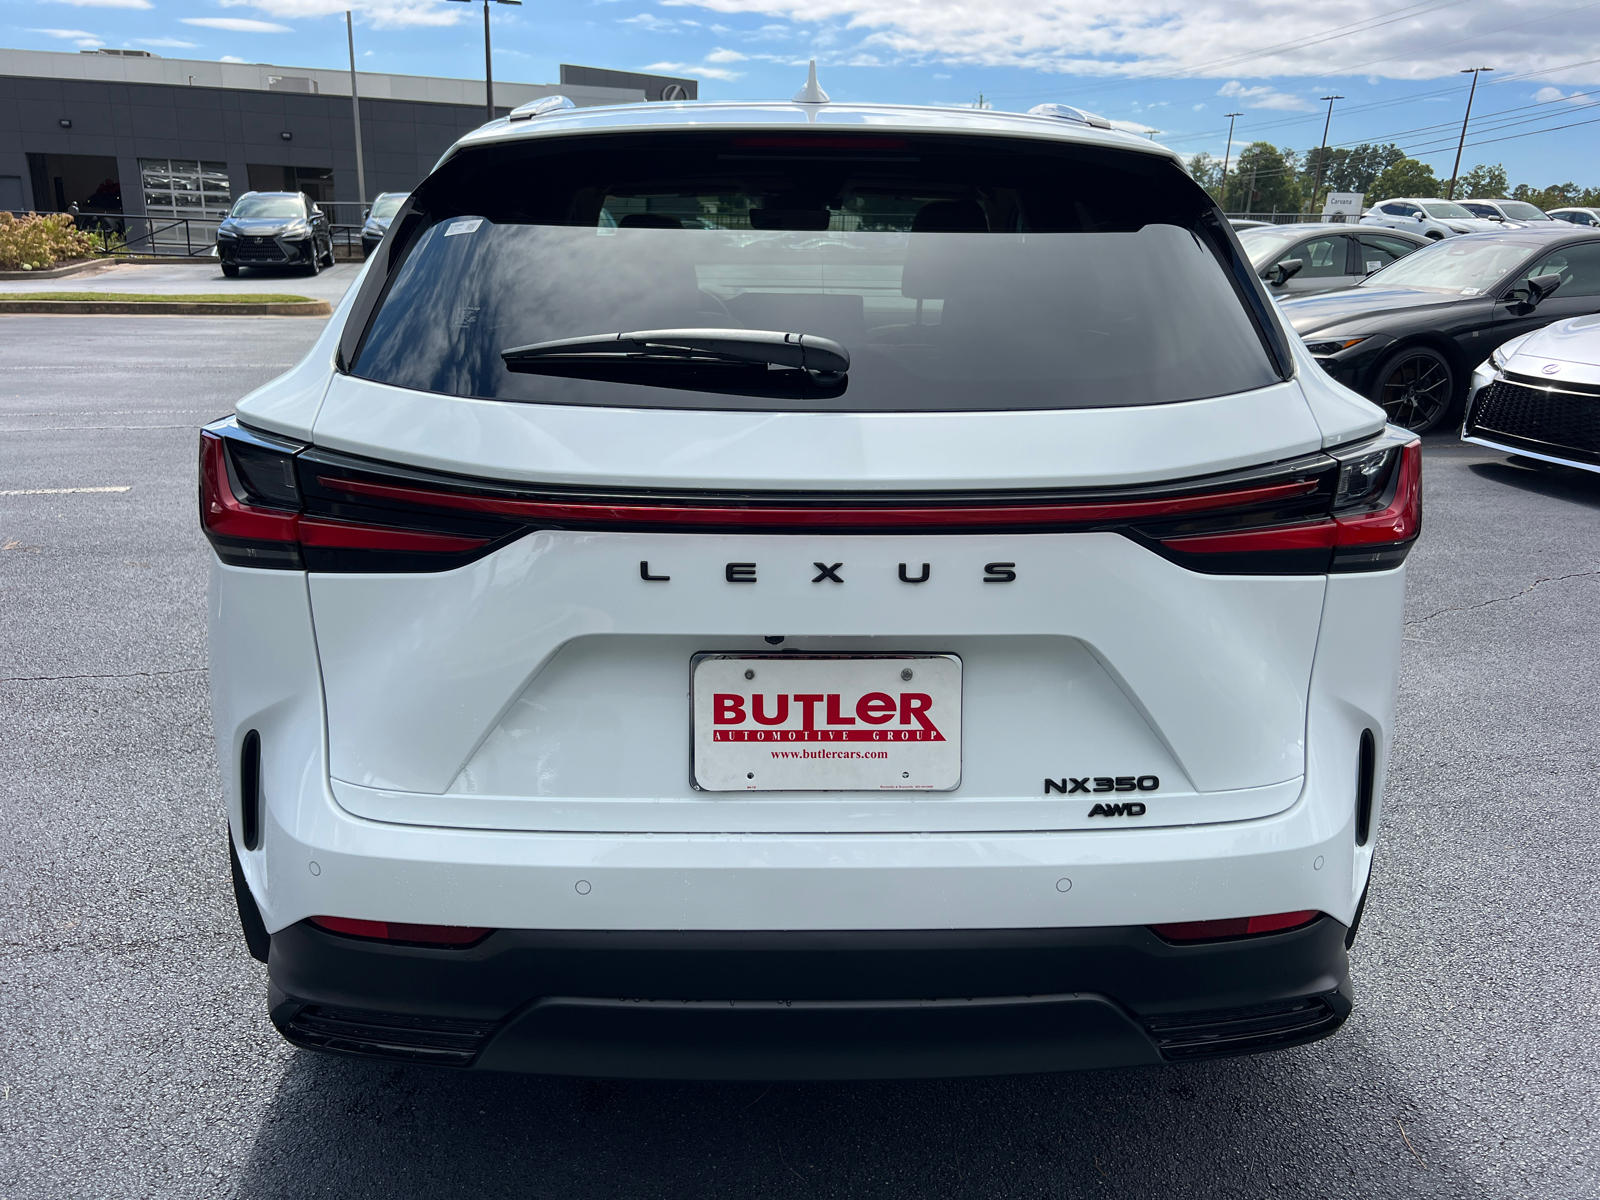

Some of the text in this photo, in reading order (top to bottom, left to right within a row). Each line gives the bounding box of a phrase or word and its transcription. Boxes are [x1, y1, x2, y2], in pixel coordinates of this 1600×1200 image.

[1330, 197, 1353, 205] Carvana
[640, 560, 1017, 583] LEXUS
[714, 730, 938, 741] AUTOMOTIVE GROUP
[770, 749, 888, 759] www.butlercars.com
[1044, 775, 1160, 794] NX350
[1087, 802, 1147, 817] AWD
